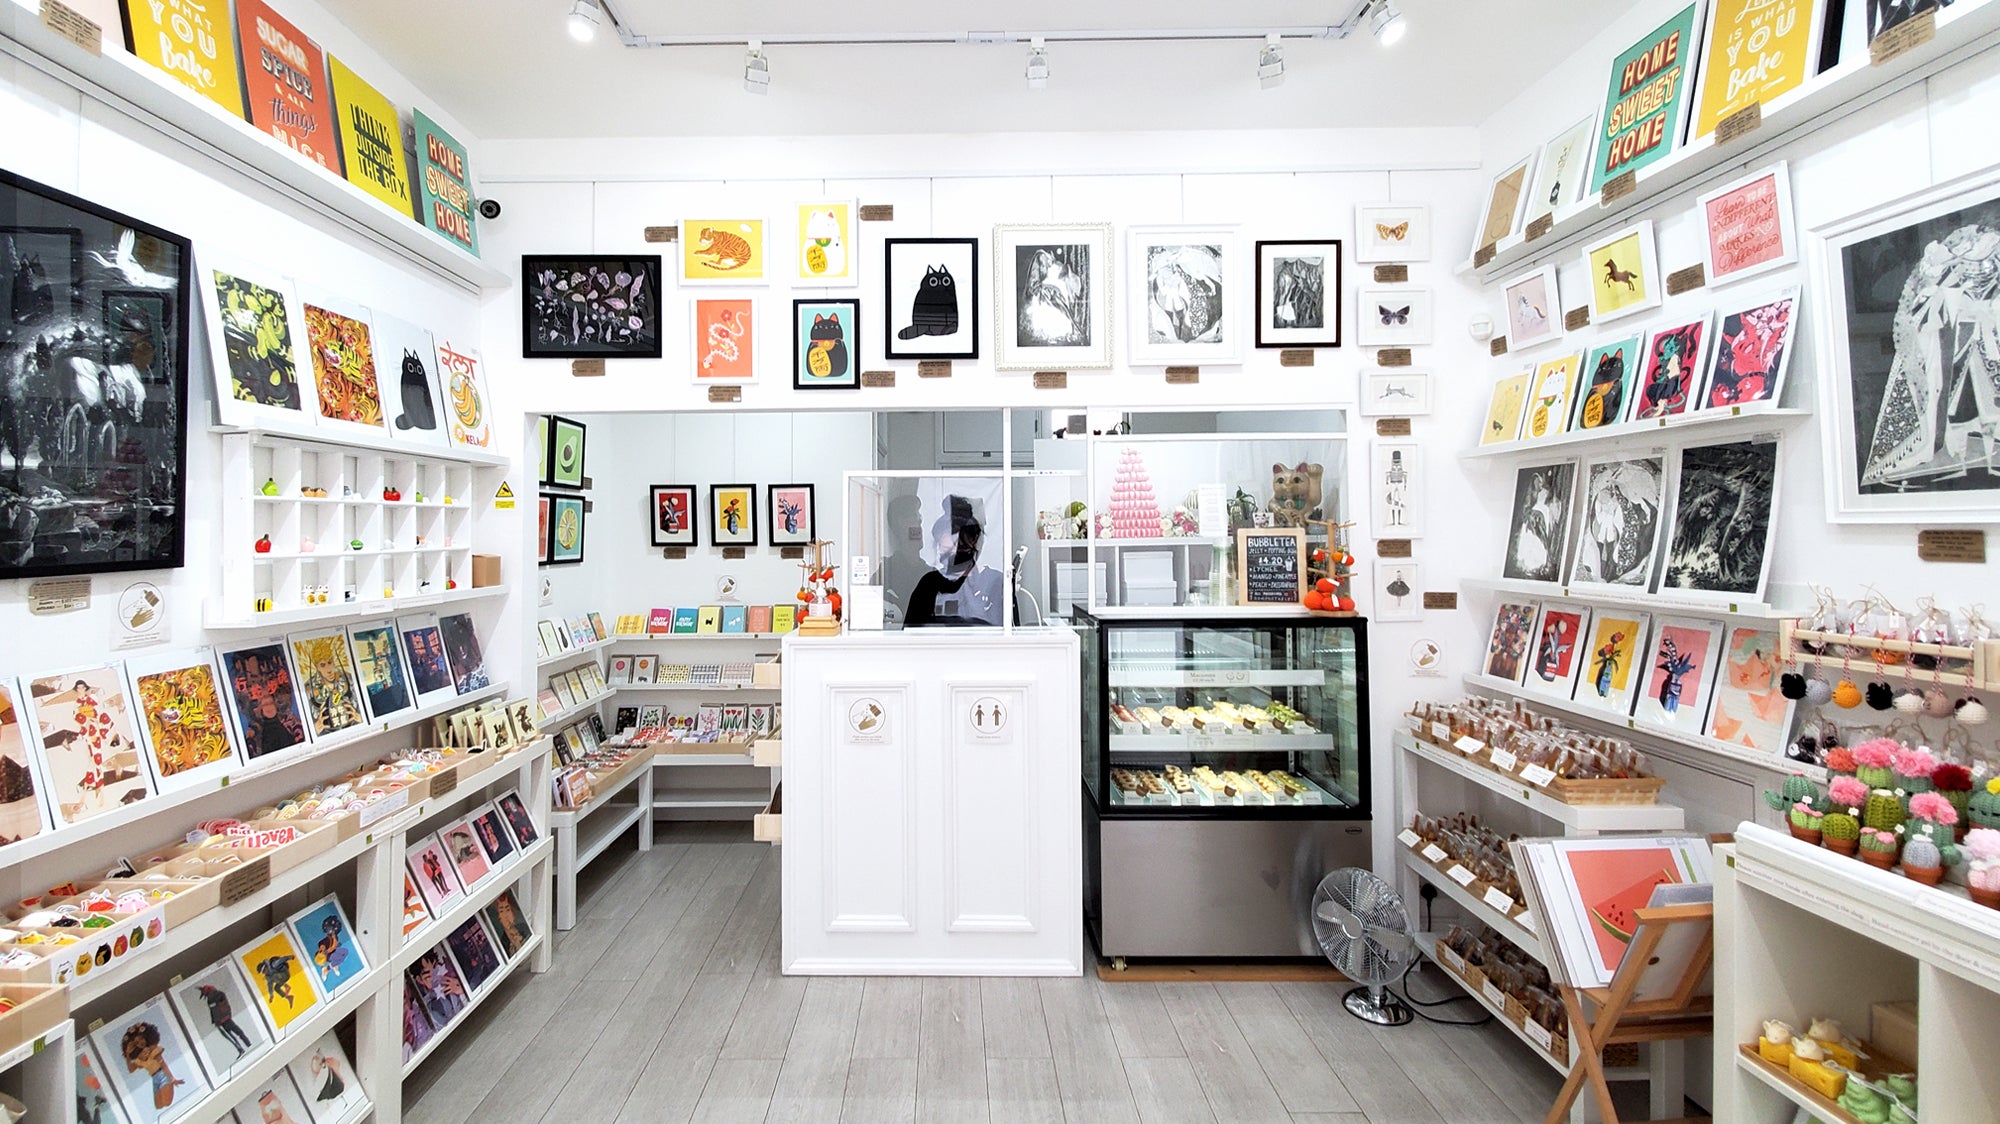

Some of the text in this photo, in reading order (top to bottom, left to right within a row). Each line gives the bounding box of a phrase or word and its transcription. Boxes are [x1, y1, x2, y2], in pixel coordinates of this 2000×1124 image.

[148, 0, 217, 60] YOU
[256, 16, 311, 75] SUGAR
[1726, 7, 1796, 67] YOU
[1728, 27, 1743, 43] IS
[159, 31, 217, 89] Bake
[260, 47, 314, 103] SPICE
[1620, 29, 1680, 97] HOME
[1726, 51, 1785, 102] Bake
[269, 97, 318, 138] things
[287, 93, 306, 111] ALL
[1607, 66, 1681, 138] SWEET
[1744, 88, 1757, 102] IT
[350, 103, 392, 150] THINK
[1605, 111, 1667, 172] HOME
[356, 133, 396, 174] OUTSIDE
[358, 156, 380, 186] THE
[427, 132, 464, 184] HOME
[425, 165, 470, 217] SWEET
[434, 201, 472, 247] HOME
